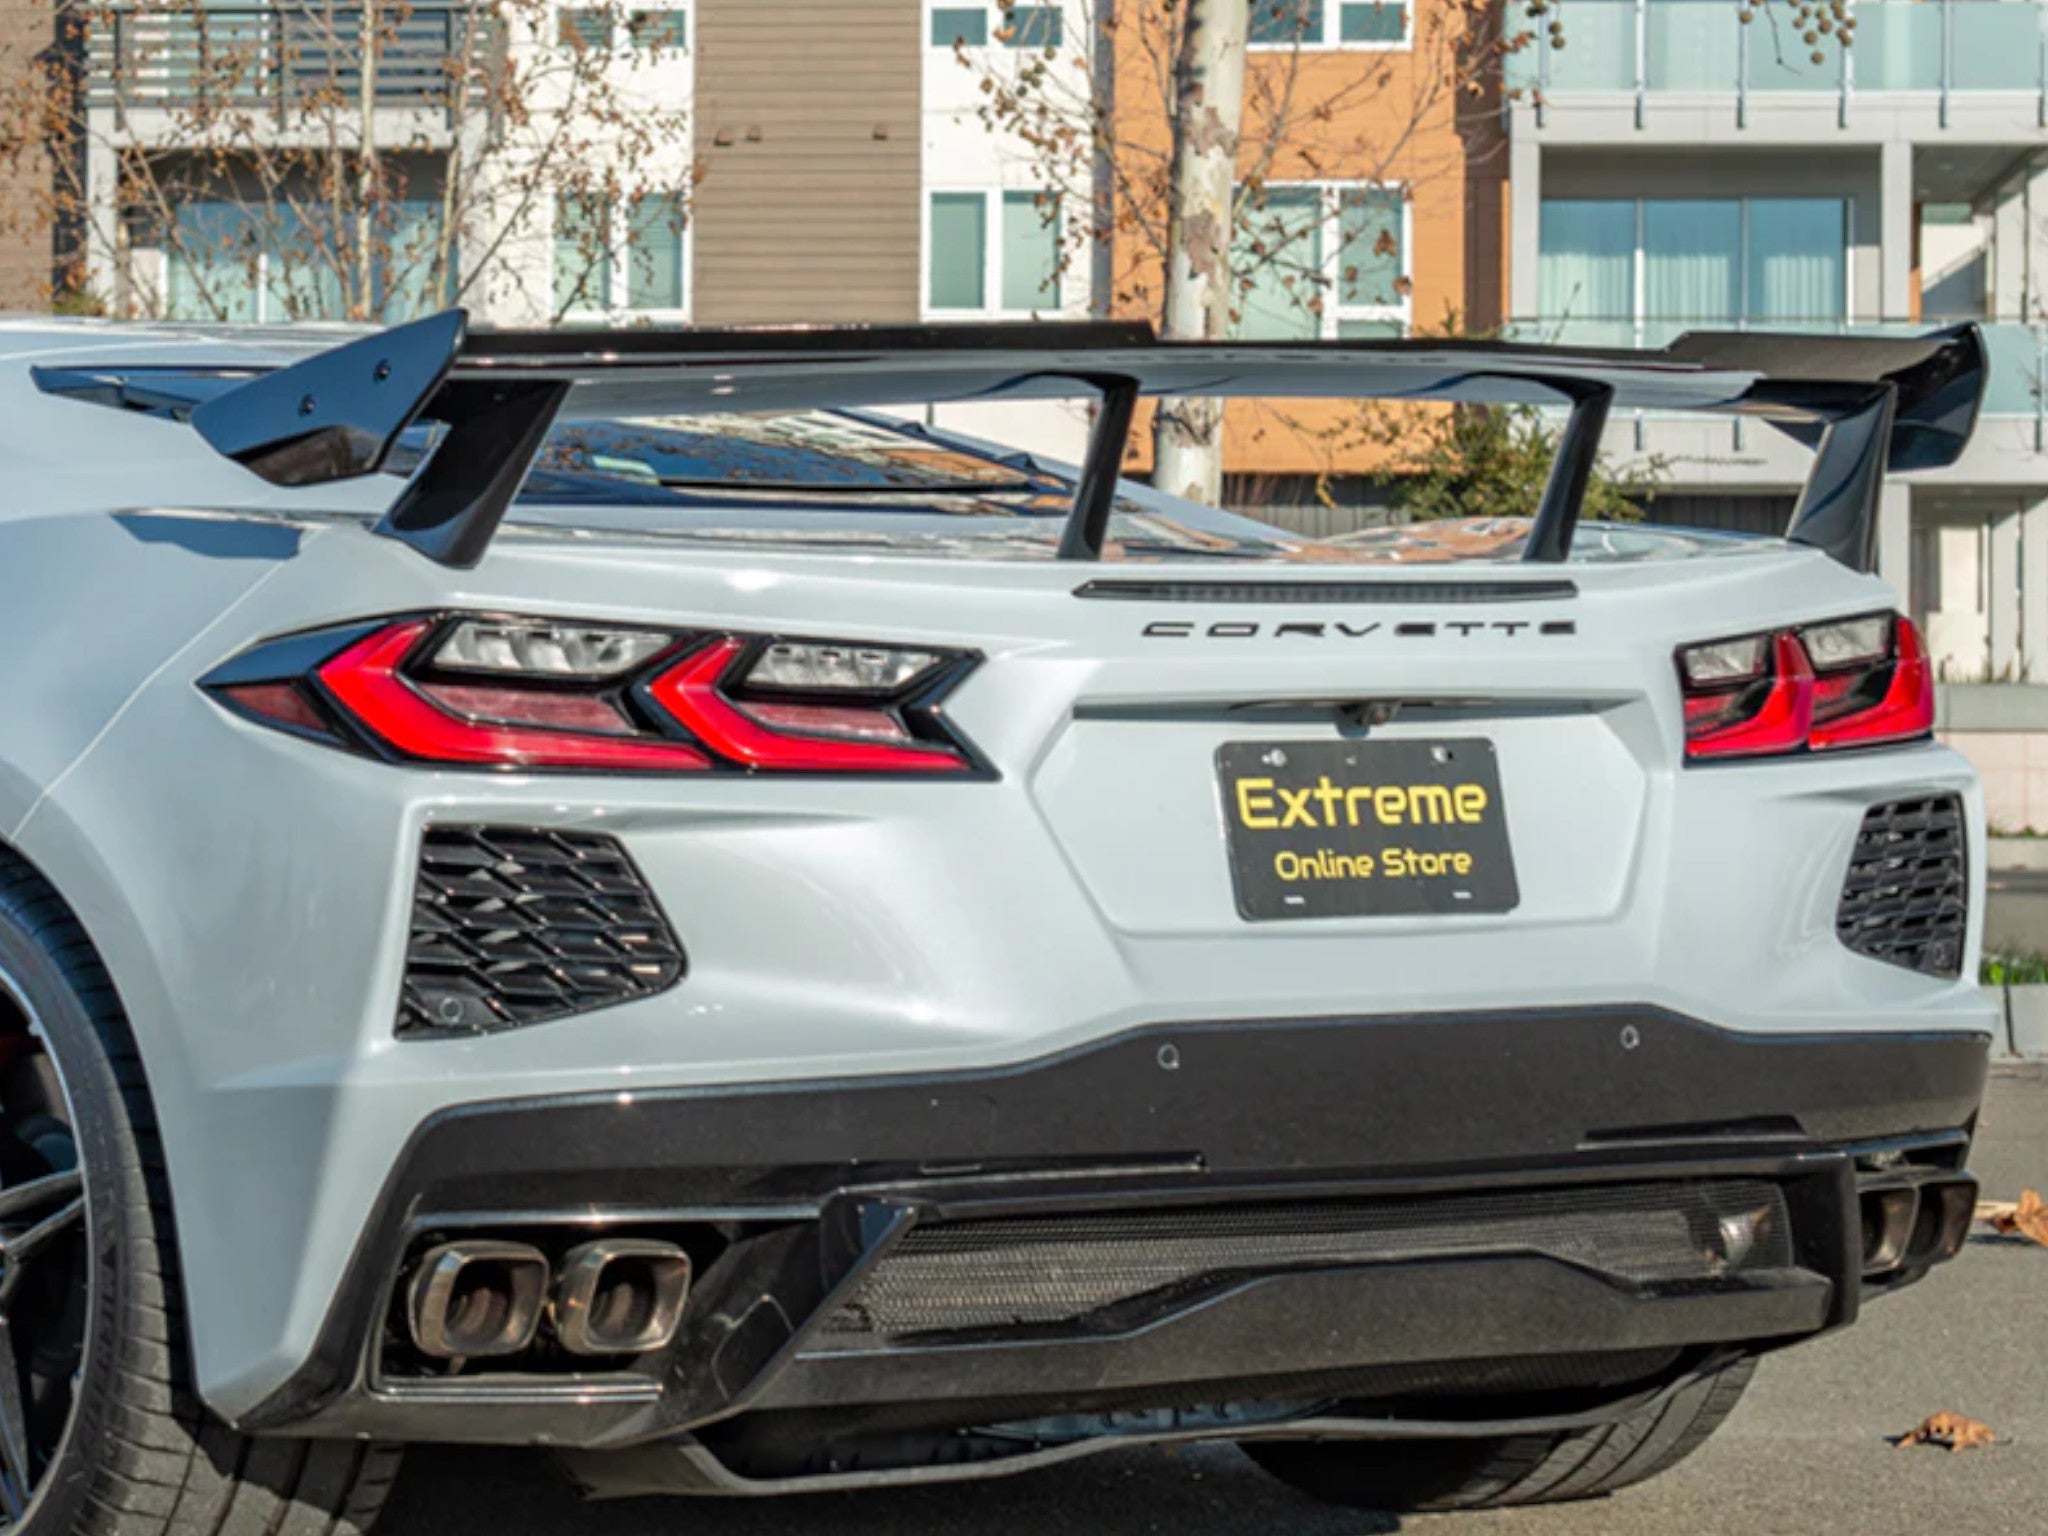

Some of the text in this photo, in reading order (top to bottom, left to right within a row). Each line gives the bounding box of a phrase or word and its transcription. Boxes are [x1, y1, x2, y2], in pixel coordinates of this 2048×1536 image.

[1142, 621, 1576, 637] CORVETTE
[1236, 775, 1488, 829] Extreme
[1273, 847, 1473, 881] Online Store
